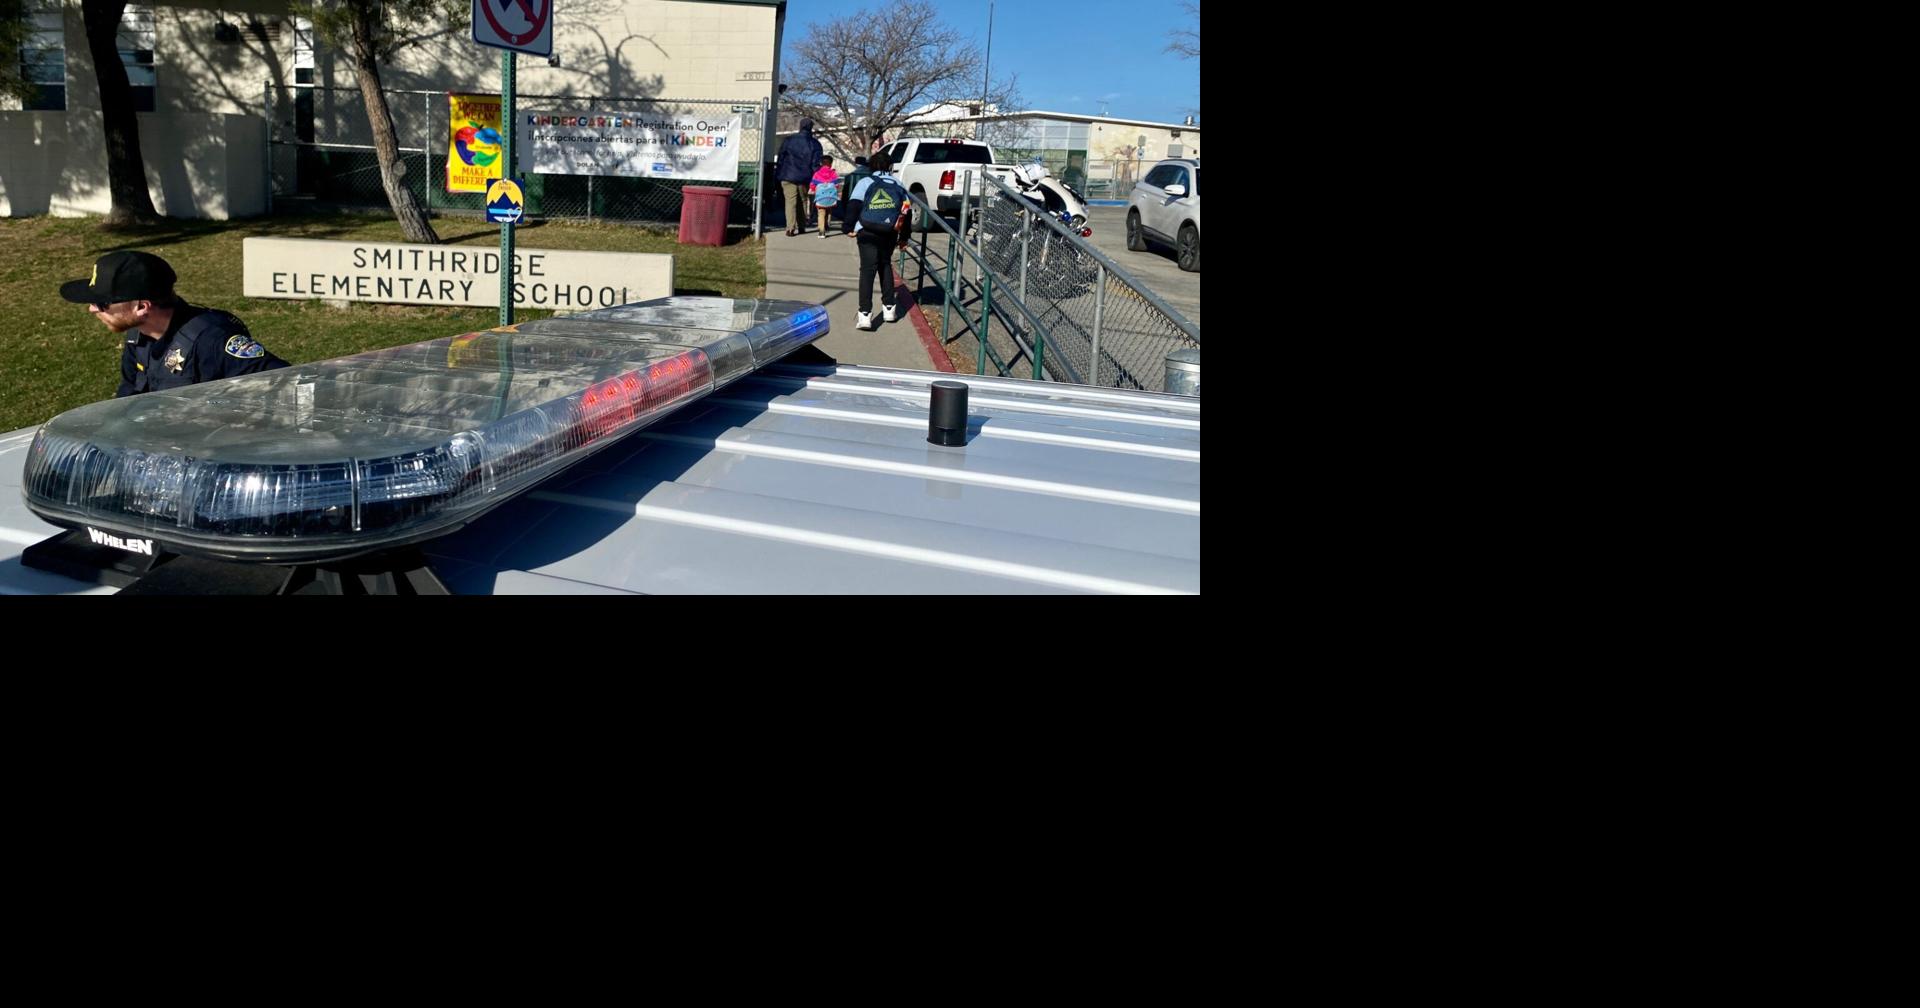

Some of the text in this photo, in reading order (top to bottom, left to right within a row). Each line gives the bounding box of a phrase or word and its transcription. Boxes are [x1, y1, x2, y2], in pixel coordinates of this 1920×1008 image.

[527, 115, 633, 128] KINDERGARTEN
[635, 118, 694, 132] Registration
[696, 120, 730, 134] Open!
[595, 132, 634, 144] abiertas
[636, 137, 657, 146] para
[660, 135, 669, 145] el
[453, 176, 487, 185] DIFFERE
[462, 167, 485, 177] MAKE
[353, 247, 545, 276] SMITHRIDGE
[273, 273, 473, 302] ELEMENTARY
[87, 526, 153, 555] WHELEN
